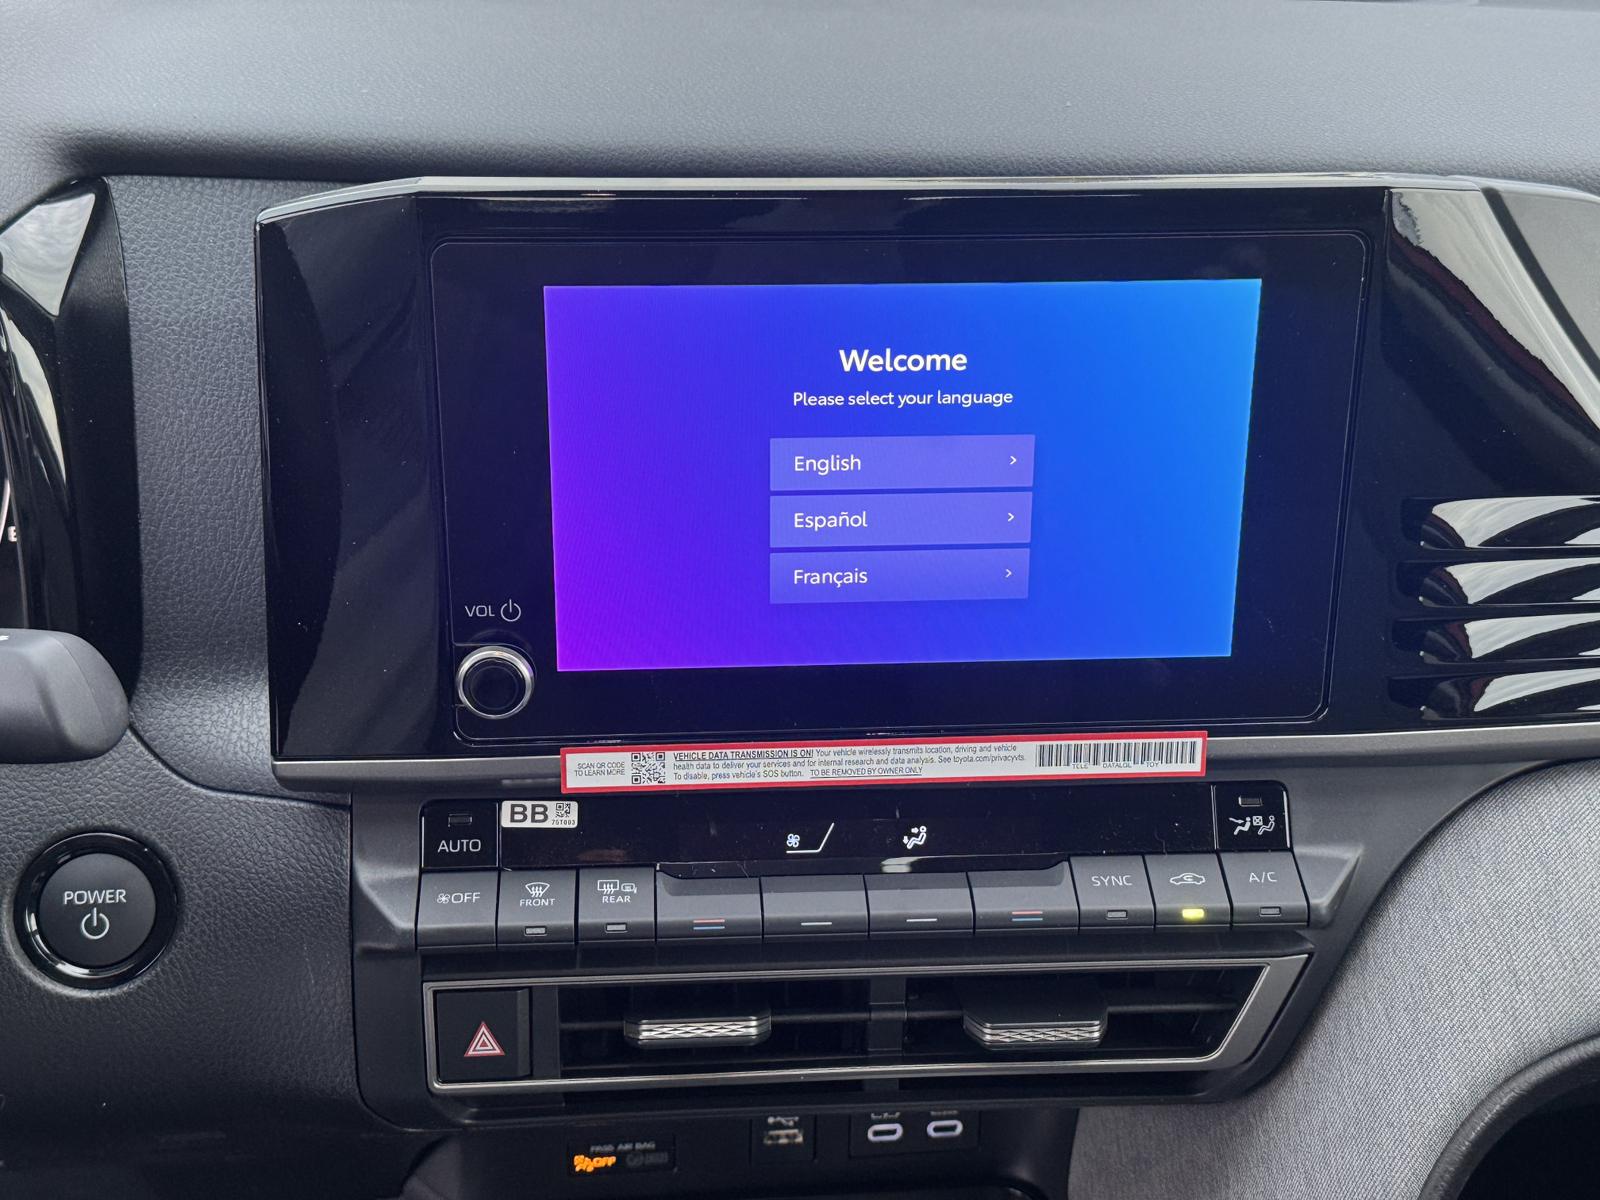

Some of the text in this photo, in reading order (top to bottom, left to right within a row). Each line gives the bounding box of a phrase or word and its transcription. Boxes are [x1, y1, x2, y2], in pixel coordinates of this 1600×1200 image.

[838, 348, 968, 373] Welcome
[793, 389, 1013, 408] Please select your language
[794, 454, 862, 475] English
[794, 511, 868, 531] Español
[794, 568, 868, 588] Français
[464, 604, 496, 618] VOL
[673, 751, 707, 761] VEHICLE
[708, 750, 729, 760] DATA
[730, 748, 789, 760] TRANSMISSION
[790, 748, 798, 758] IS
[815, 747, 832, 757] Your
[832, 747, 857, 757] vehicle
[858, 745, 892, 757] wirelessly
[893, 744, 924, 754] transmits
[924, 744, 953, 754] location,
[955, 743, 977, 755] driving
[979, 743, 992, 753] and
[993, 742, 1017, 752] vehicle
[577, 760, 626, 770] SCAN QR CODE
[673, 761, 695, 771] health
[695, 761, 711, 770] data
[713, 761, 720, 770] to
[721, 760, 745, 770] deliver
[746, 761, 762, 771] your
[762, 760, 791, 769] services
[792, 759, 806, 768] and
[807, 758, 817, 767] for
[818, 758, 843, 768] internal
[844, 757, 875, 767] research
[875, 757, 889, 766] and
[890, 756, 906, 765] data
[906, 755, 937, 767] analysis.
[937, 754, 952, 764] See
[1146, 760, 1159, 768] TOY
[574, 768, 626, 777] TO LEARN MORE
[673, 764, 923, 781] To disable, press vehicle's SOS button. TO BE REMOVED BY OWNER ONLY
[510, 803, 549, 823] BB
[437, 838, 482, 853] AUTO
[1091, 875, 1133, 887] SYNC
[1249, 871, 1278, 884] A/C
[63, 889, 127, 905] POWER
[451, 892, 481, 904] OFF
[519, 898, 555, 908] FRONT
[602, 894, 631, 904] REAR
